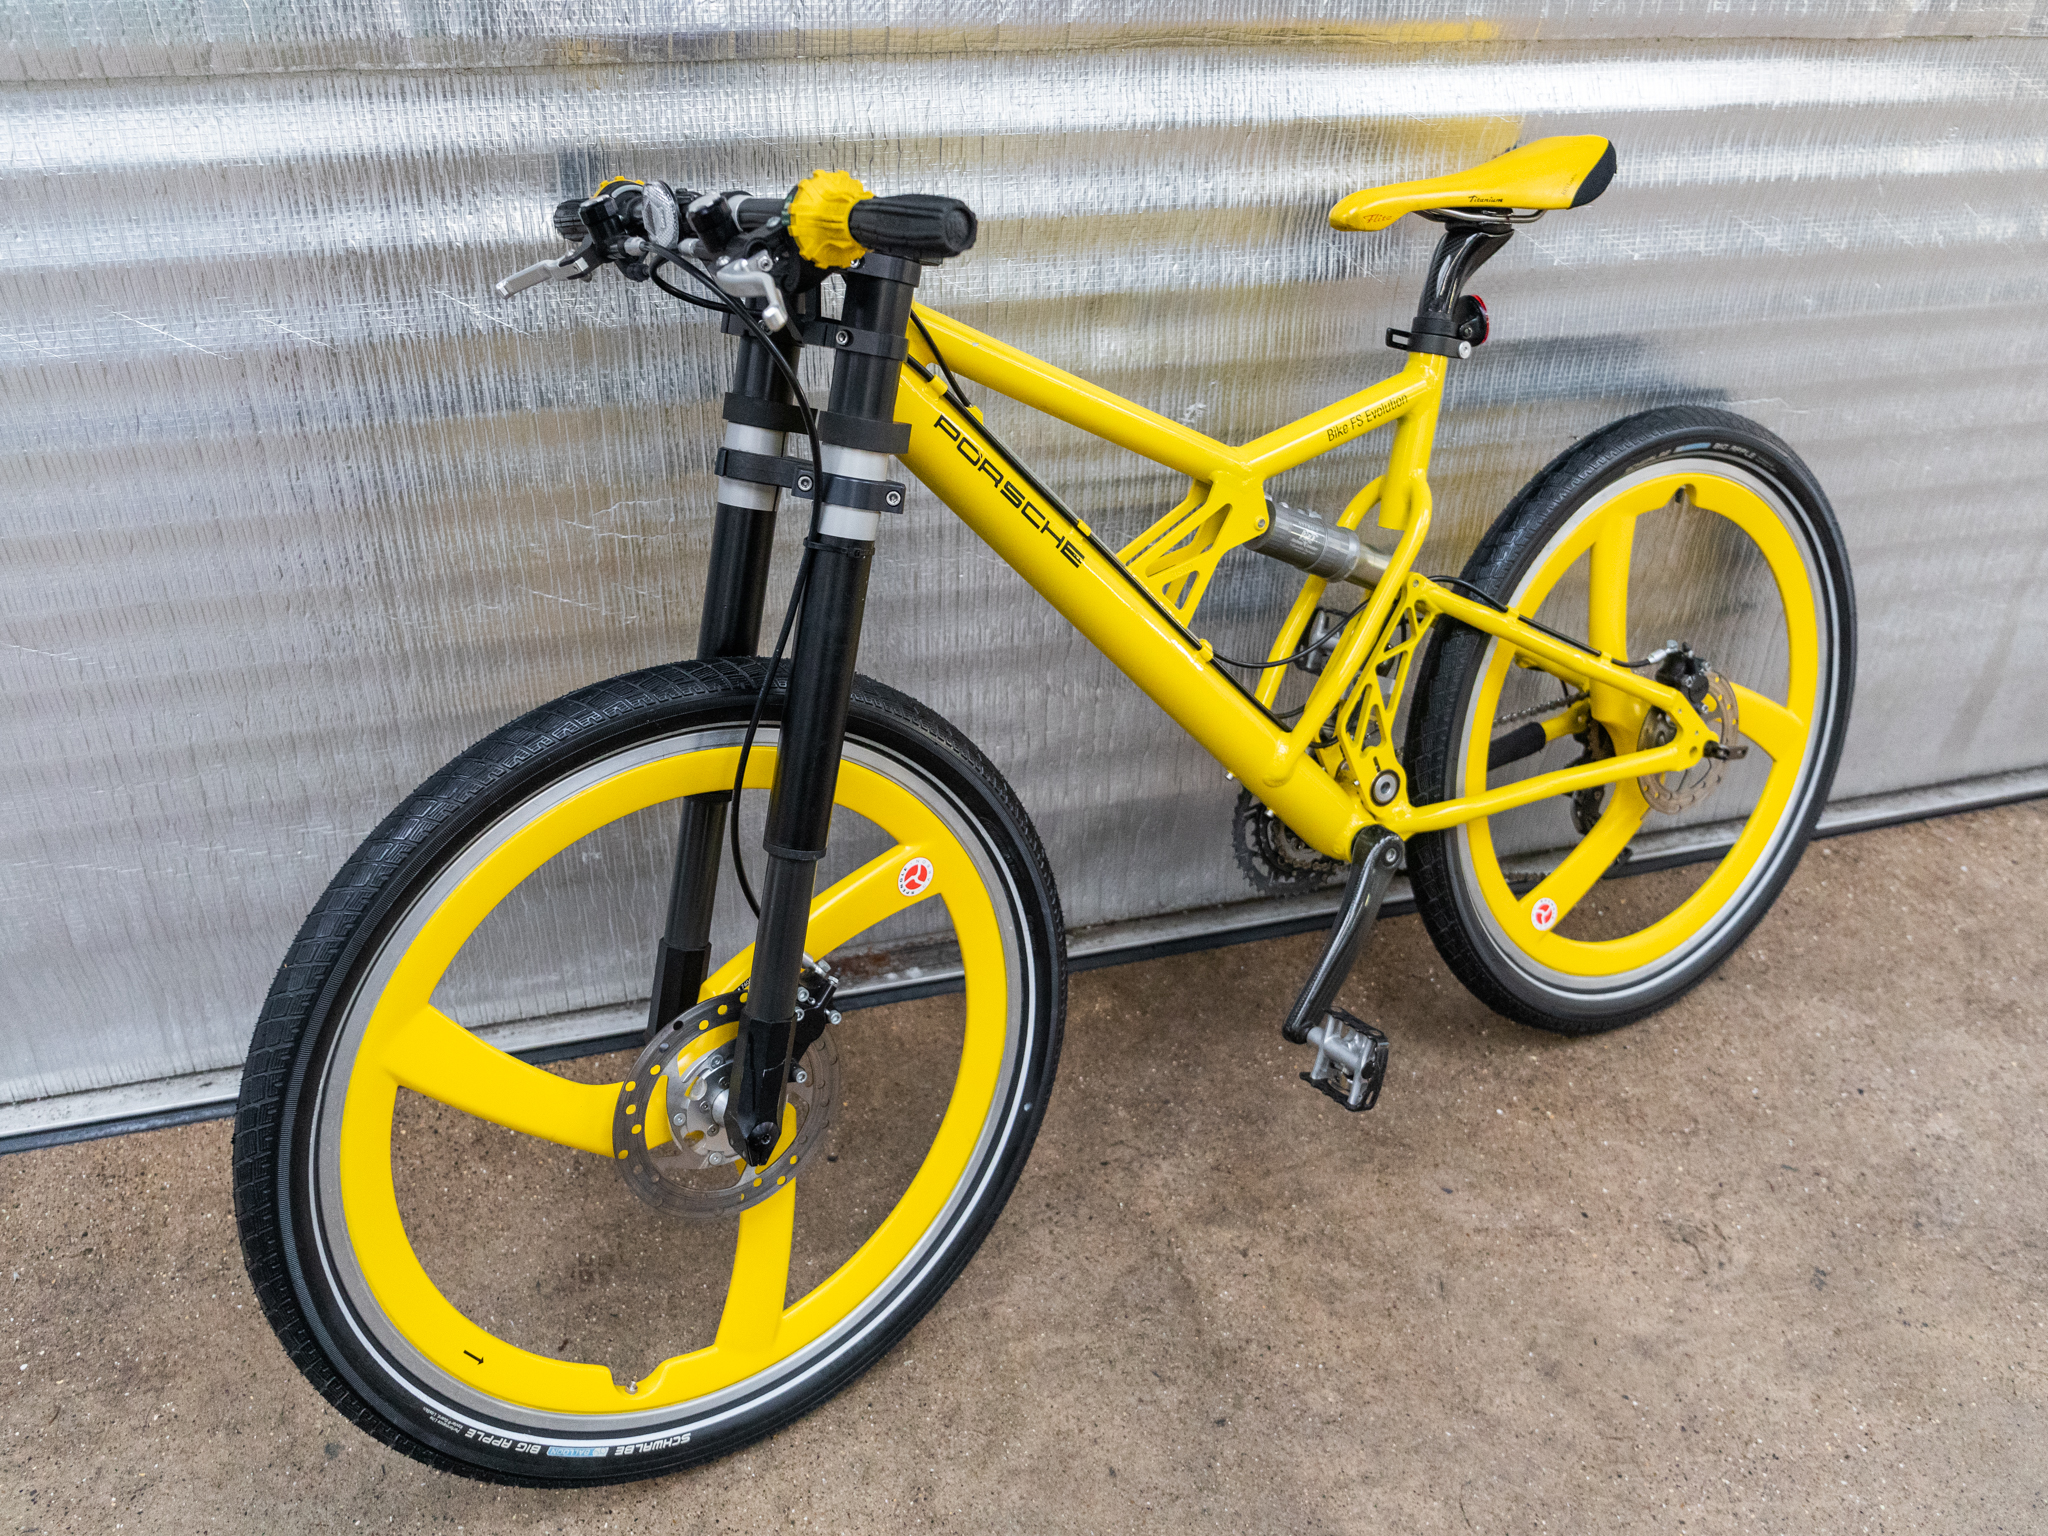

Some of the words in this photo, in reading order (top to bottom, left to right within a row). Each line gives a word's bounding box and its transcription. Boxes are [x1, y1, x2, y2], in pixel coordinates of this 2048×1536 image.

[1468, 195, 1503, 203] Titanium
[1363, 213, 1392, 224] Flite
[1326, 423, 1349, 442] Bike
[1350, 414, 1364, 430] FS
[1364, 395, 1408, 423] Evolution
[933, 414, 1085, 568] PORSCHE
[464, 1428, 513, 1449] APPLE
[614, 1432, 692, 1456] SCHWALBE
[514, 1442, 541, 1455] BIG
[550, 1448, 591, 1457] BALLOON
